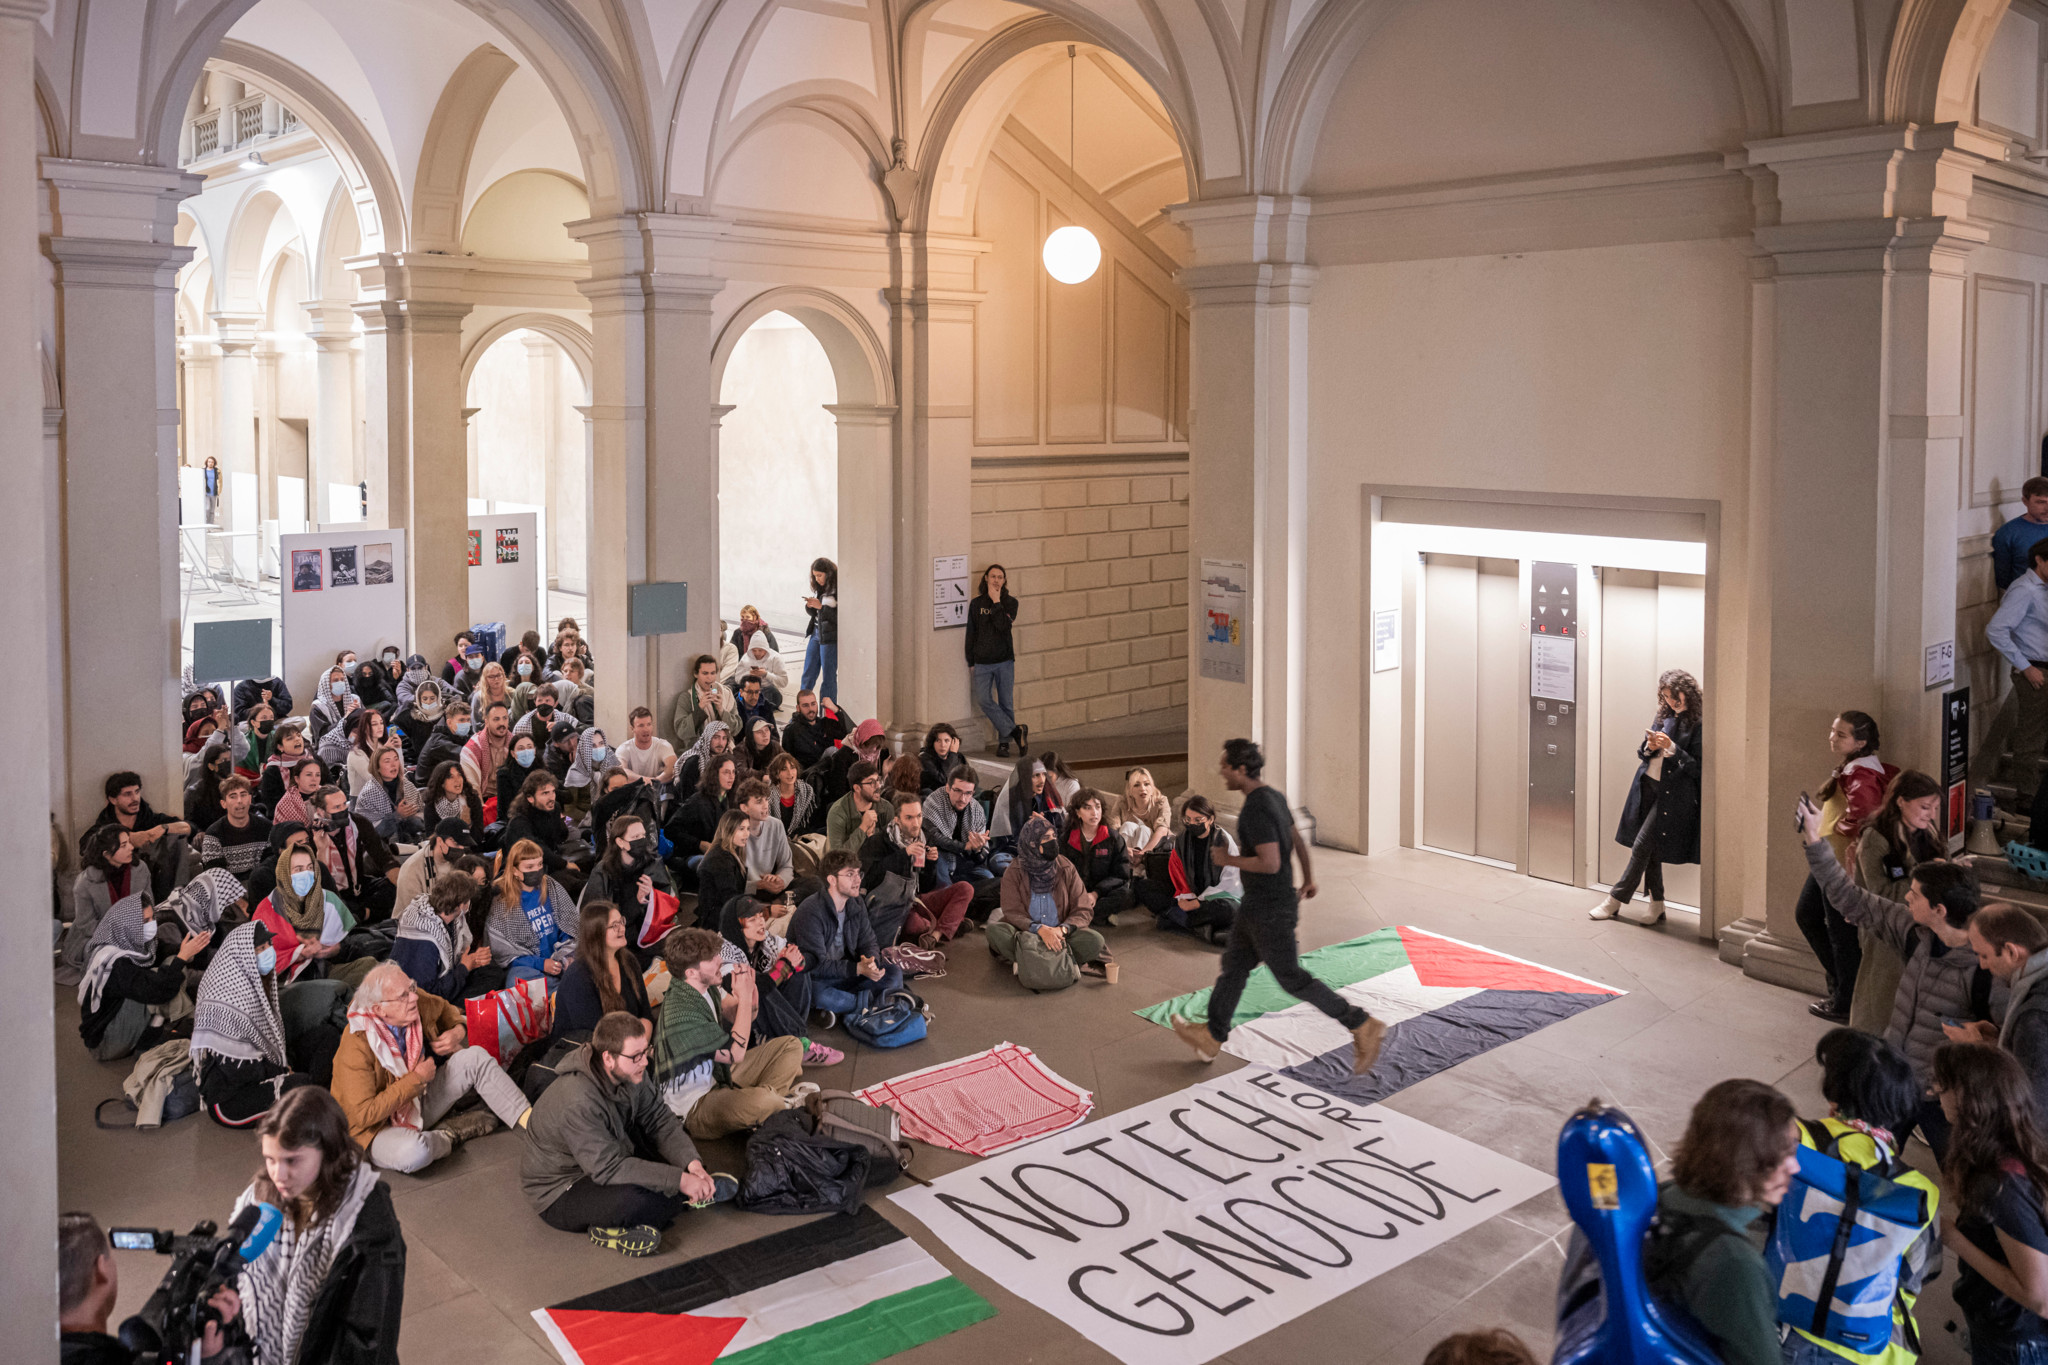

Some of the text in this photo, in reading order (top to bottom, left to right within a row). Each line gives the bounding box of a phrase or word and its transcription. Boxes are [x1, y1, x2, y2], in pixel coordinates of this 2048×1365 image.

[1246, 1072, 1383, 1132] FOR
[934, 1090, 1325, 1261] NO TECH
